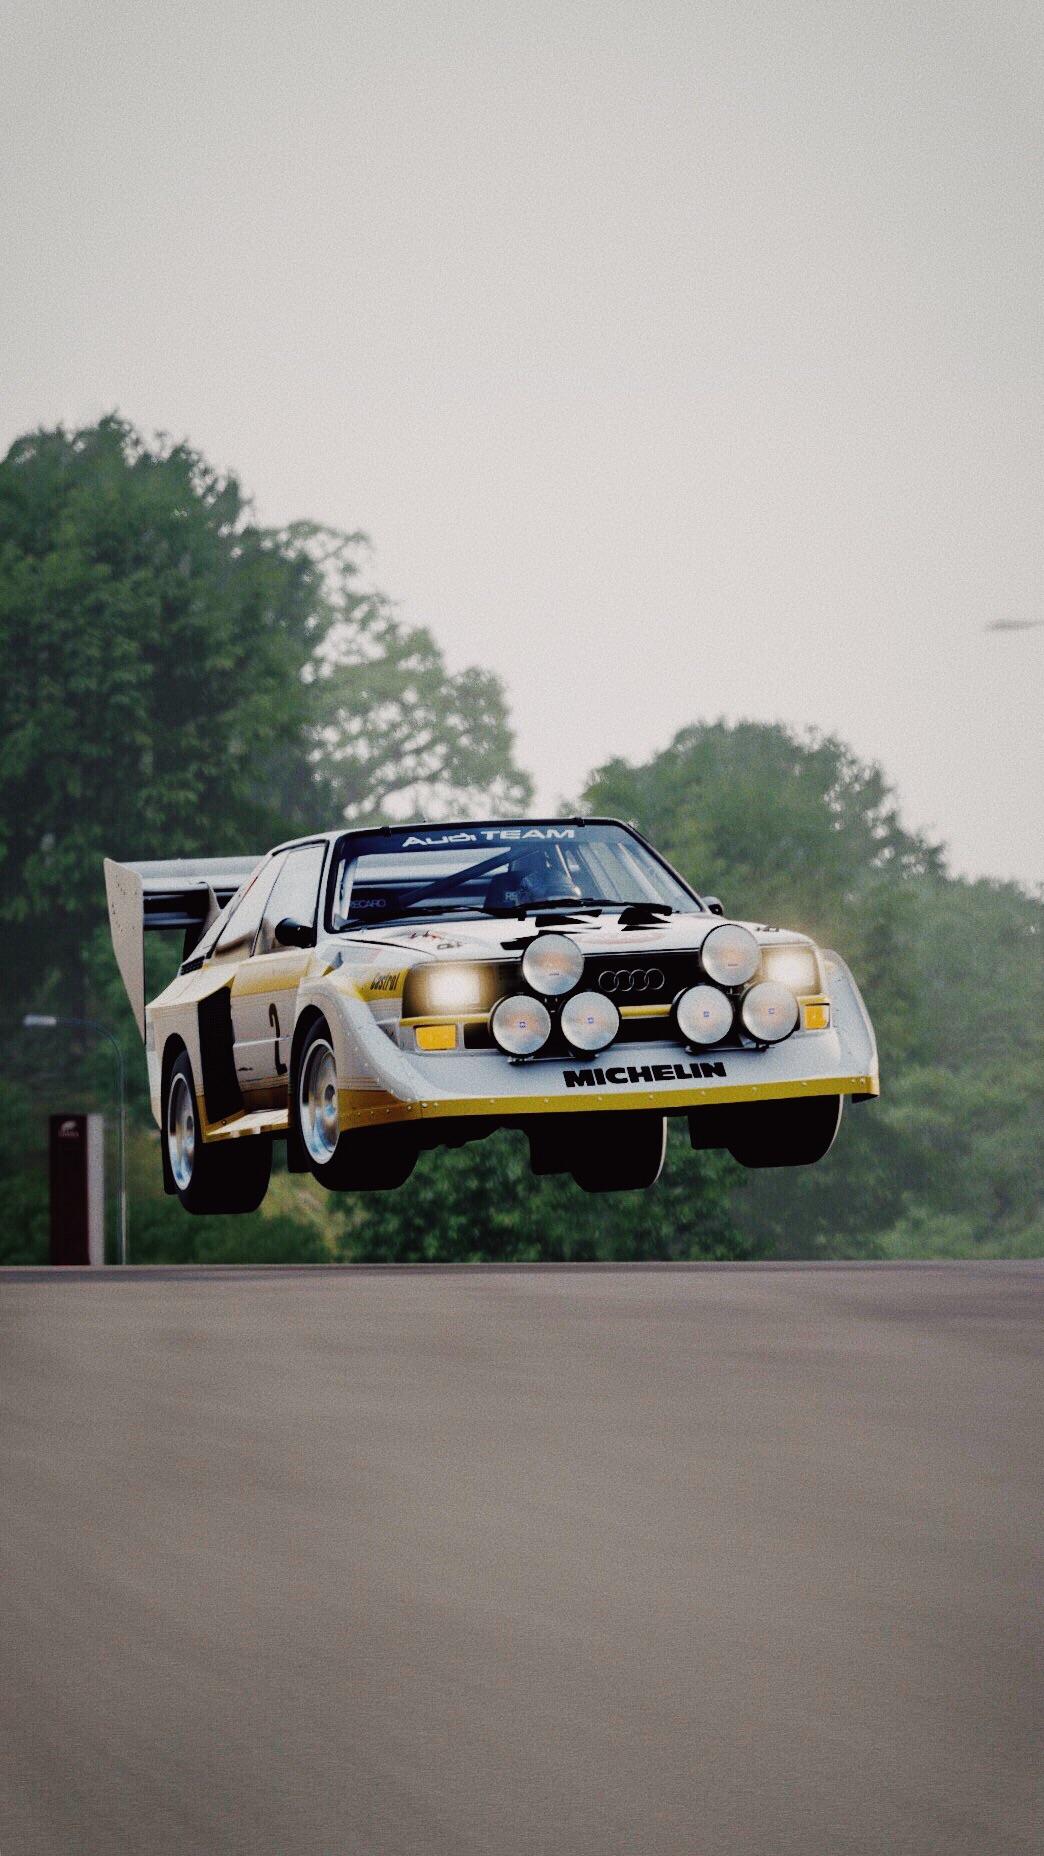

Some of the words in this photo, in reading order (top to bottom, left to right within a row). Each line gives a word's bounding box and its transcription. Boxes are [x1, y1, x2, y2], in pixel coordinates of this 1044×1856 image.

[480, 829, 575, 841] TEAM
[269, 1003, 288, 1075] 2
[562, 1062, 727, 1088] MICHELIN
